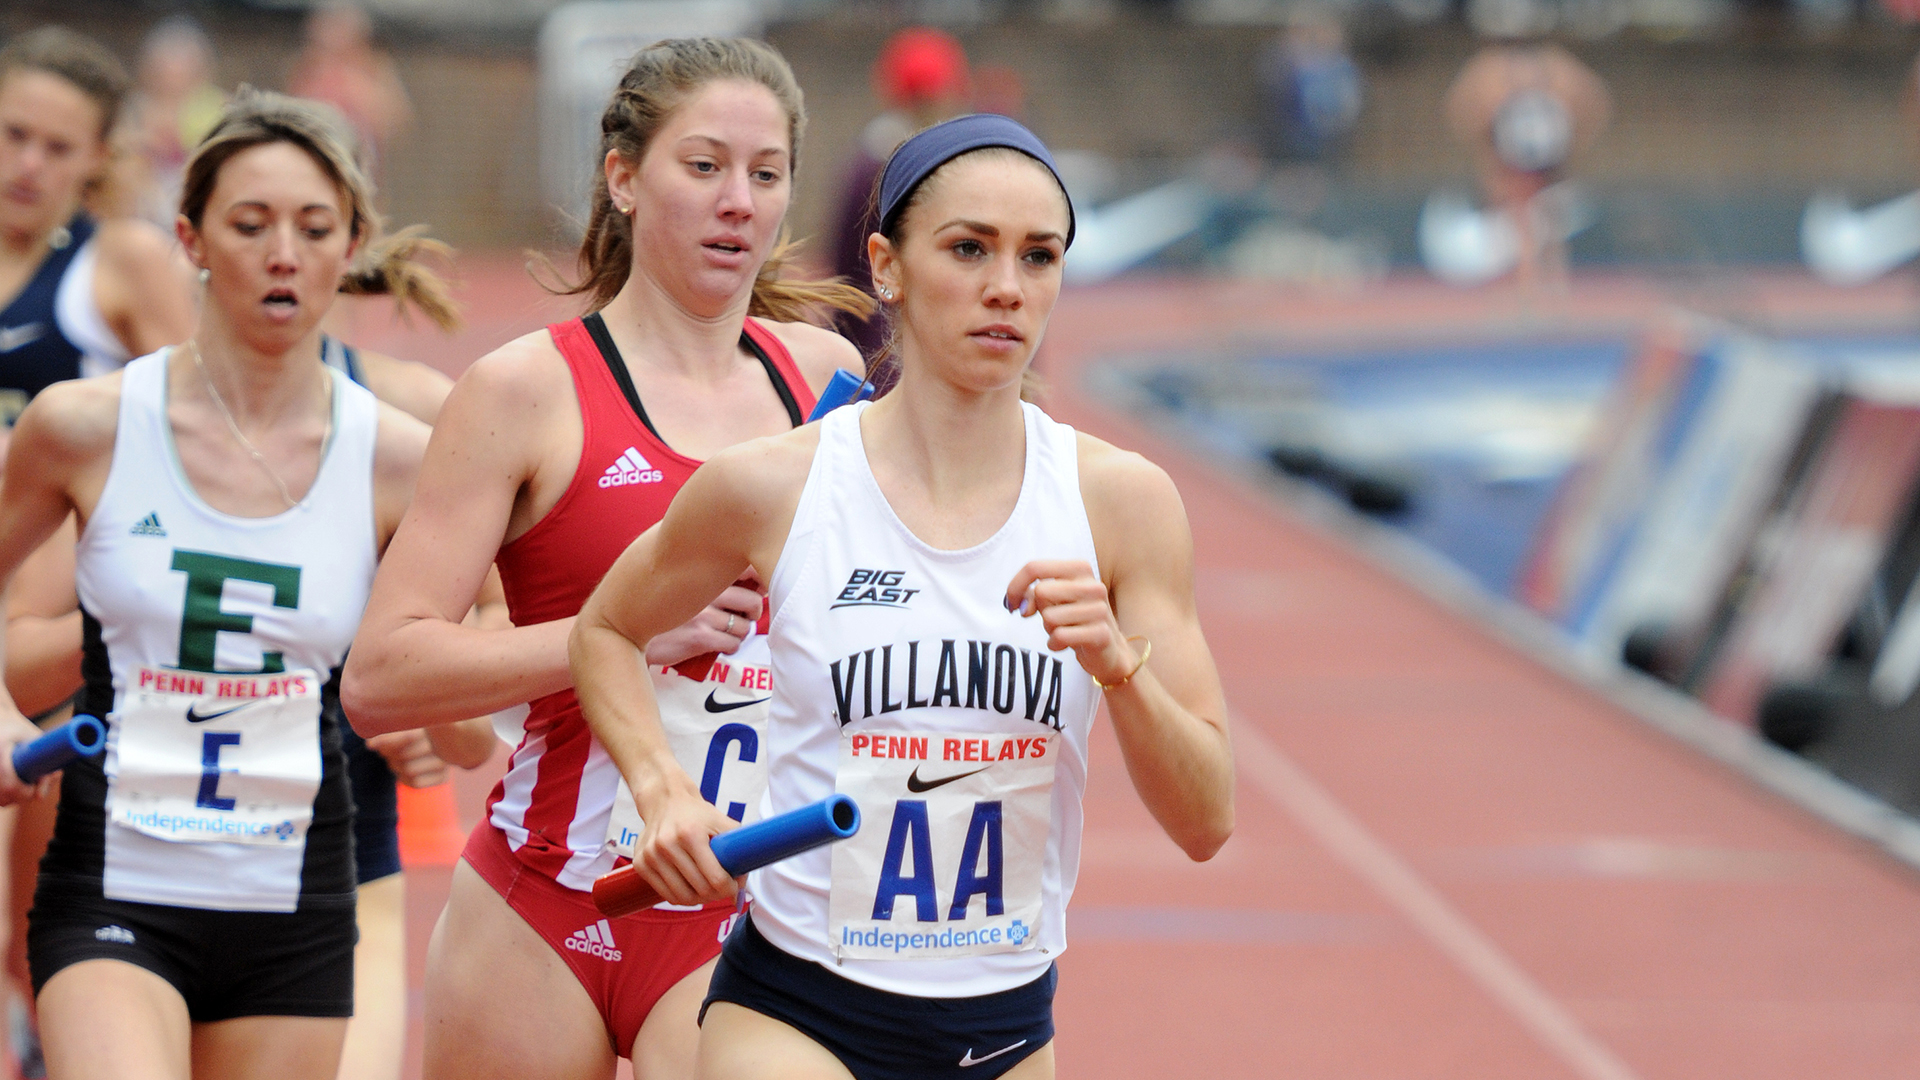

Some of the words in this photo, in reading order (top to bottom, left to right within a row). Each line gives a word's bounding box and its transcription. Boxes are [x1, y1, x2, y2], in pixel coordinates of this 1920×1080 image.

[598, 469, 664, 489] adidas
[847, 568, 906, 586] BIG
[836, 586, 920, 604] EAST
[163, 549, 302, 674] E
[140, 671, 204, 695] PENN
[218, 674, 308, 698] RELAYS
[829, 638, 1063, 732] VILLANOVA
[852, 734, 929, 760] PENN
[943, 737, 1048, 762] RELAYS
[196, 732, 241, 811] E
[700, 723, 758, 823] C
[126, 811, 273, 834] Independence
[871, 799, 1005, 922] AA
[564, 936, 622, 962] adidas
[842, 926, 1001, 953] Independence
